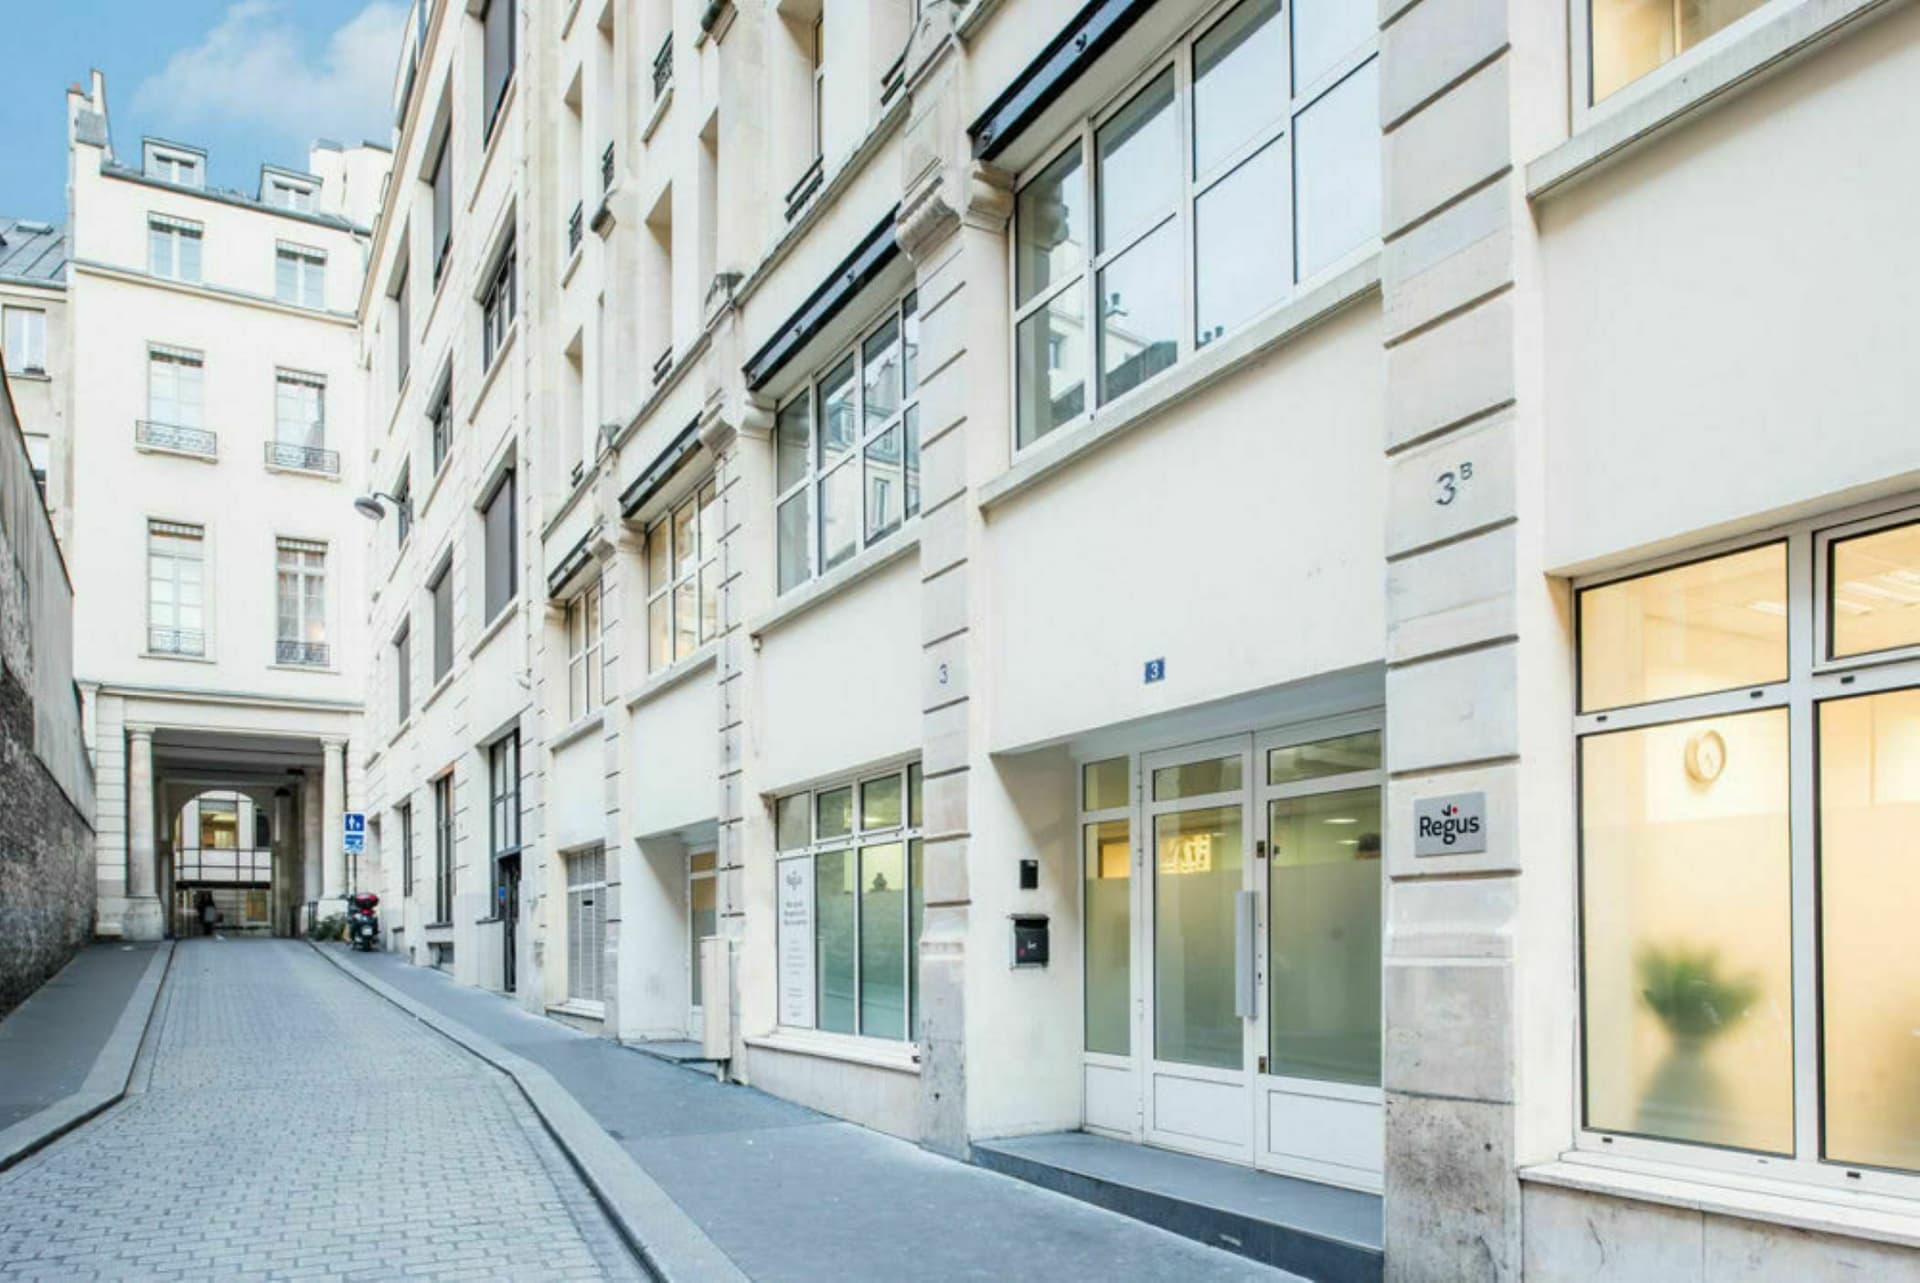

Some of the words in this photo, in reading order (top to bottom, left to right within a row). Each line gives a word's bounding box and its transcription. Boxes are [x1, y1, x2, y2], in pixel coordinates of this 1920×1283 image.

[939, 663, 949, 684] 3
[1150, 662, 1160, 679] 3
[1419, 815, 1480, 845] Regus
